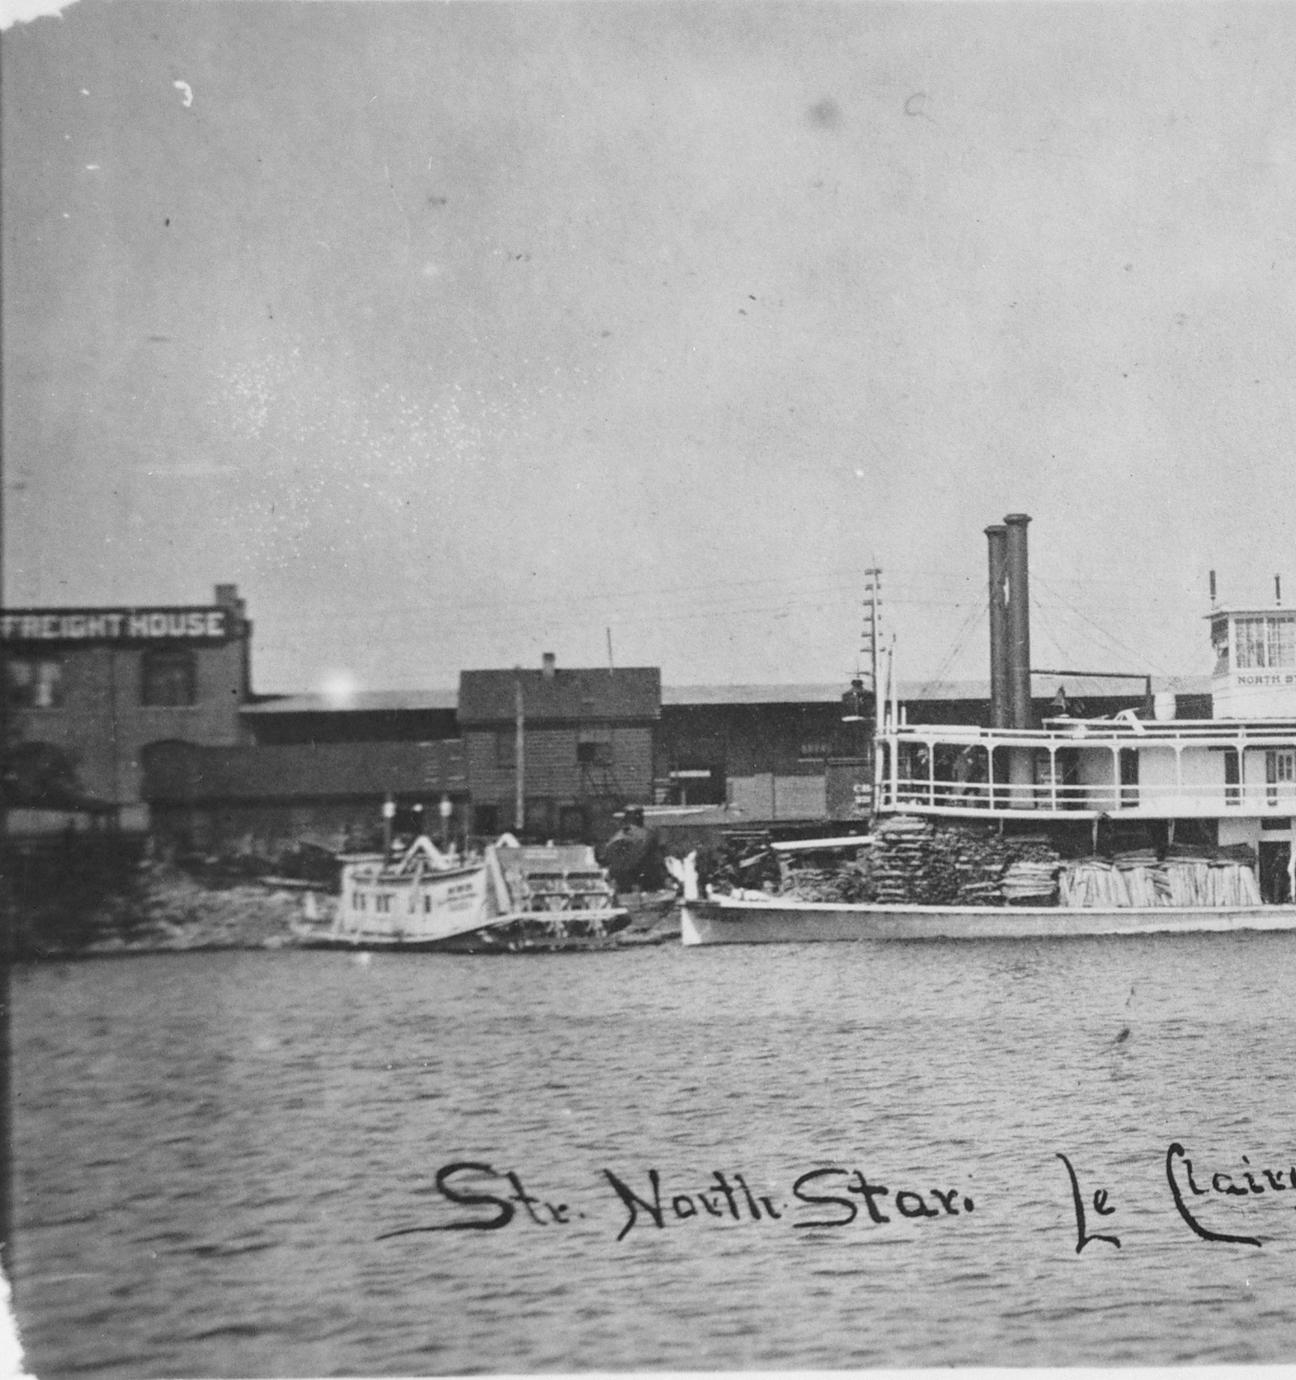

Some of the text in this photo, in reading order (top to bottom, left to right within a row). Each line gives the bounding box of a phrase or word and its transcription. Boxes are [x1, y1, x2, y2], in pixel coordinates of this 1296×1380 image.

[1, 611, 225, 639] FREIGHT HOUSE
[1237, 674, 1281, 685] NORTH
